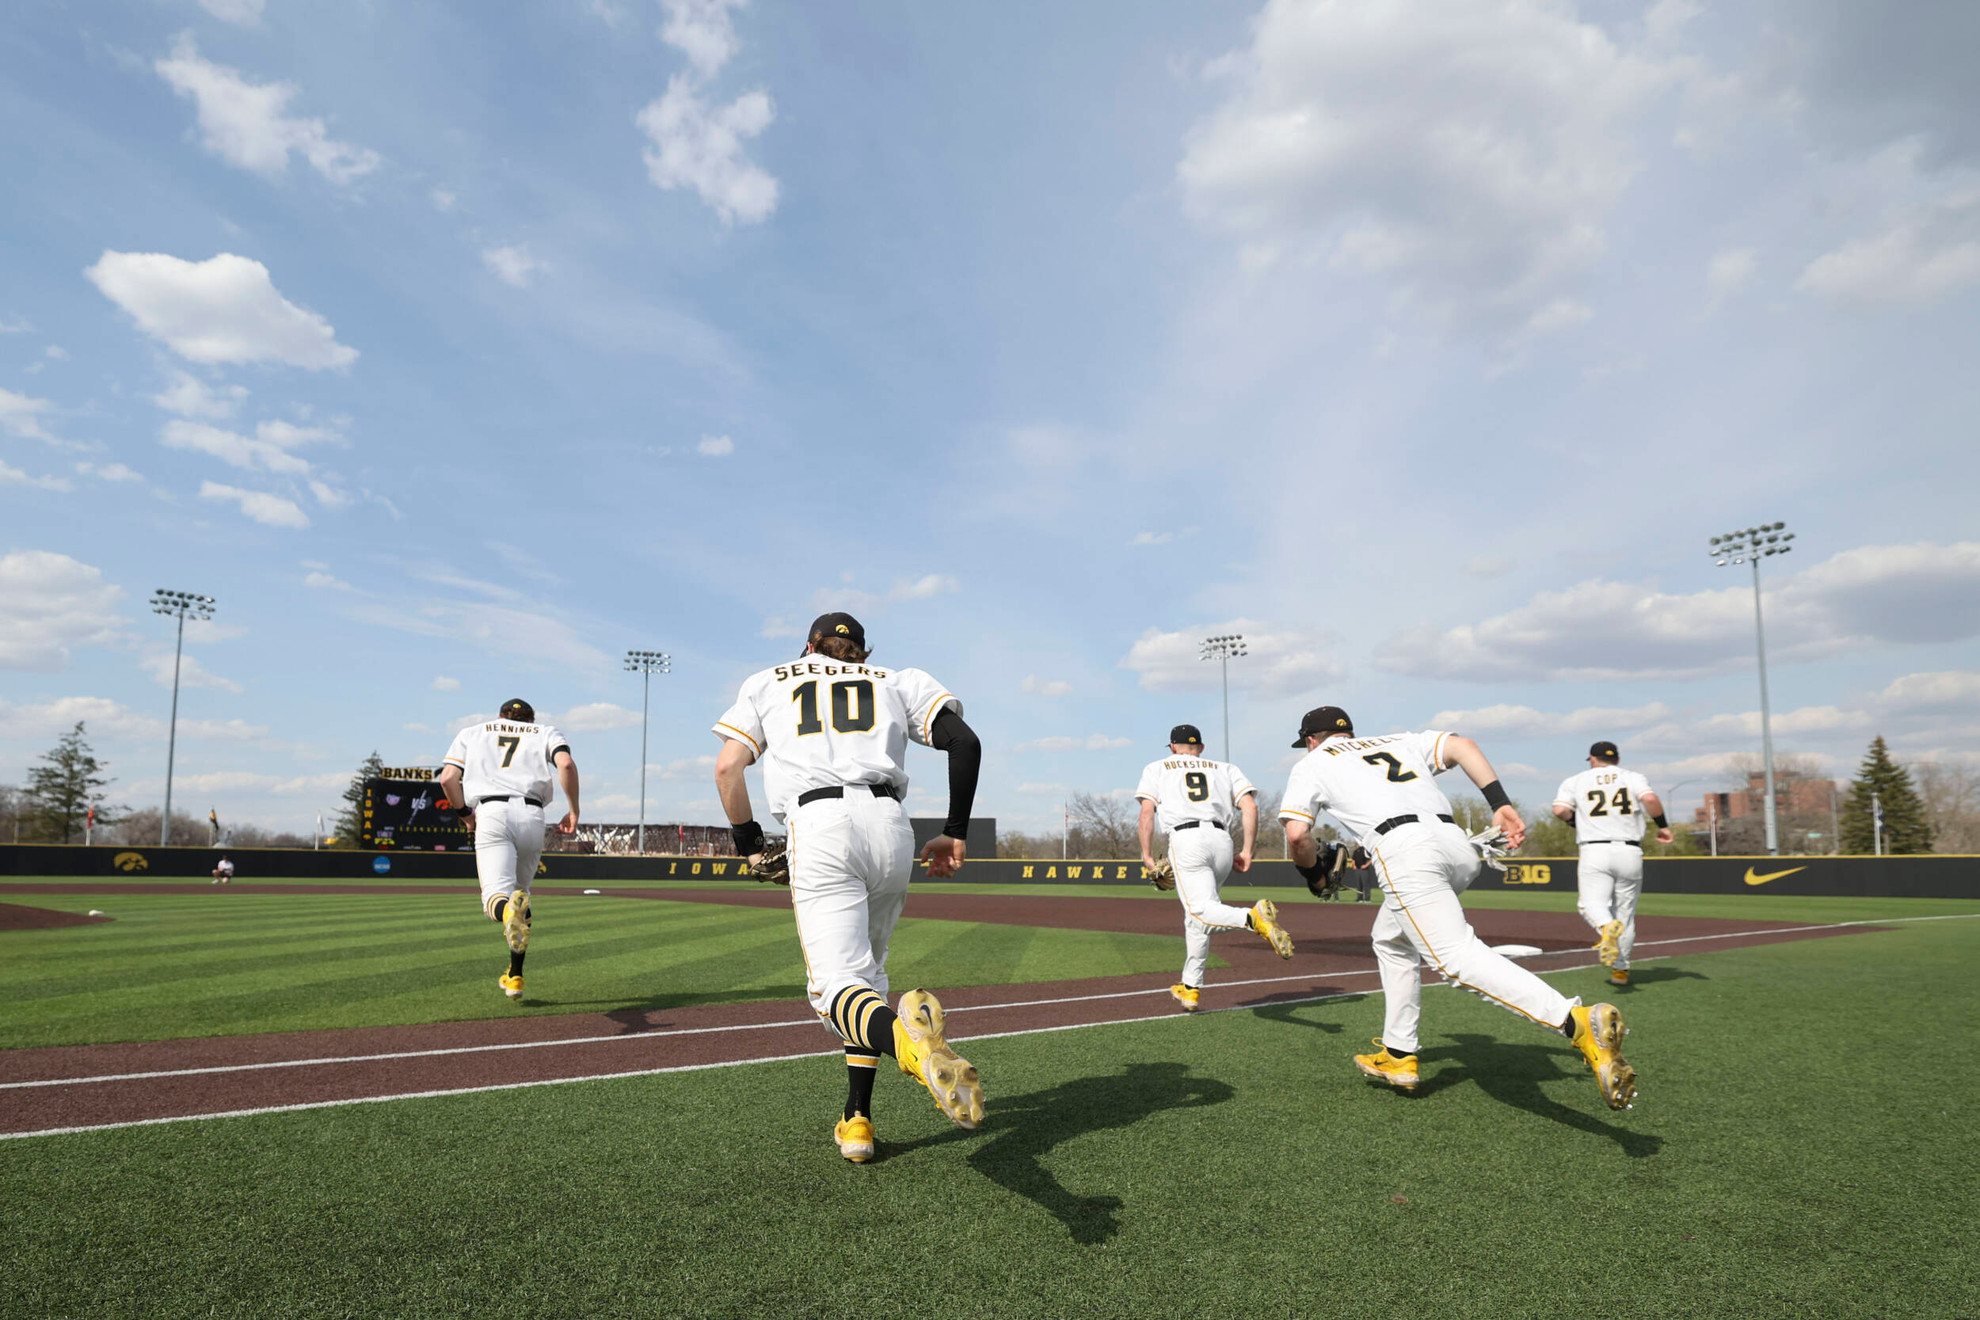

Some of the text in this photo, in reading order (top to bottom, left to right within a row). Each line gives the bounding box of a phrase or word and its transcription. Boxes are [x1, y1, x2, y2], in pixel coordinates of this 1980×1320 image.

[774, 663, 887, 682] SEEGERS
[792, 679, 877, 737] 10
[485, 723, 539, 734] HENNINGS
[498, 735, 520, 769] 7
[1361, 751, 1418, 783] 2
[382, 767, 432, 780] BANKS
[1185, 771, 1210, 803] 9
[363, 788, 374, 830] IOWA
[411, 798, 426, 810] VS
[1587, 787, 1632, 817] 24
[669, 862, 748, 875] IOWA
